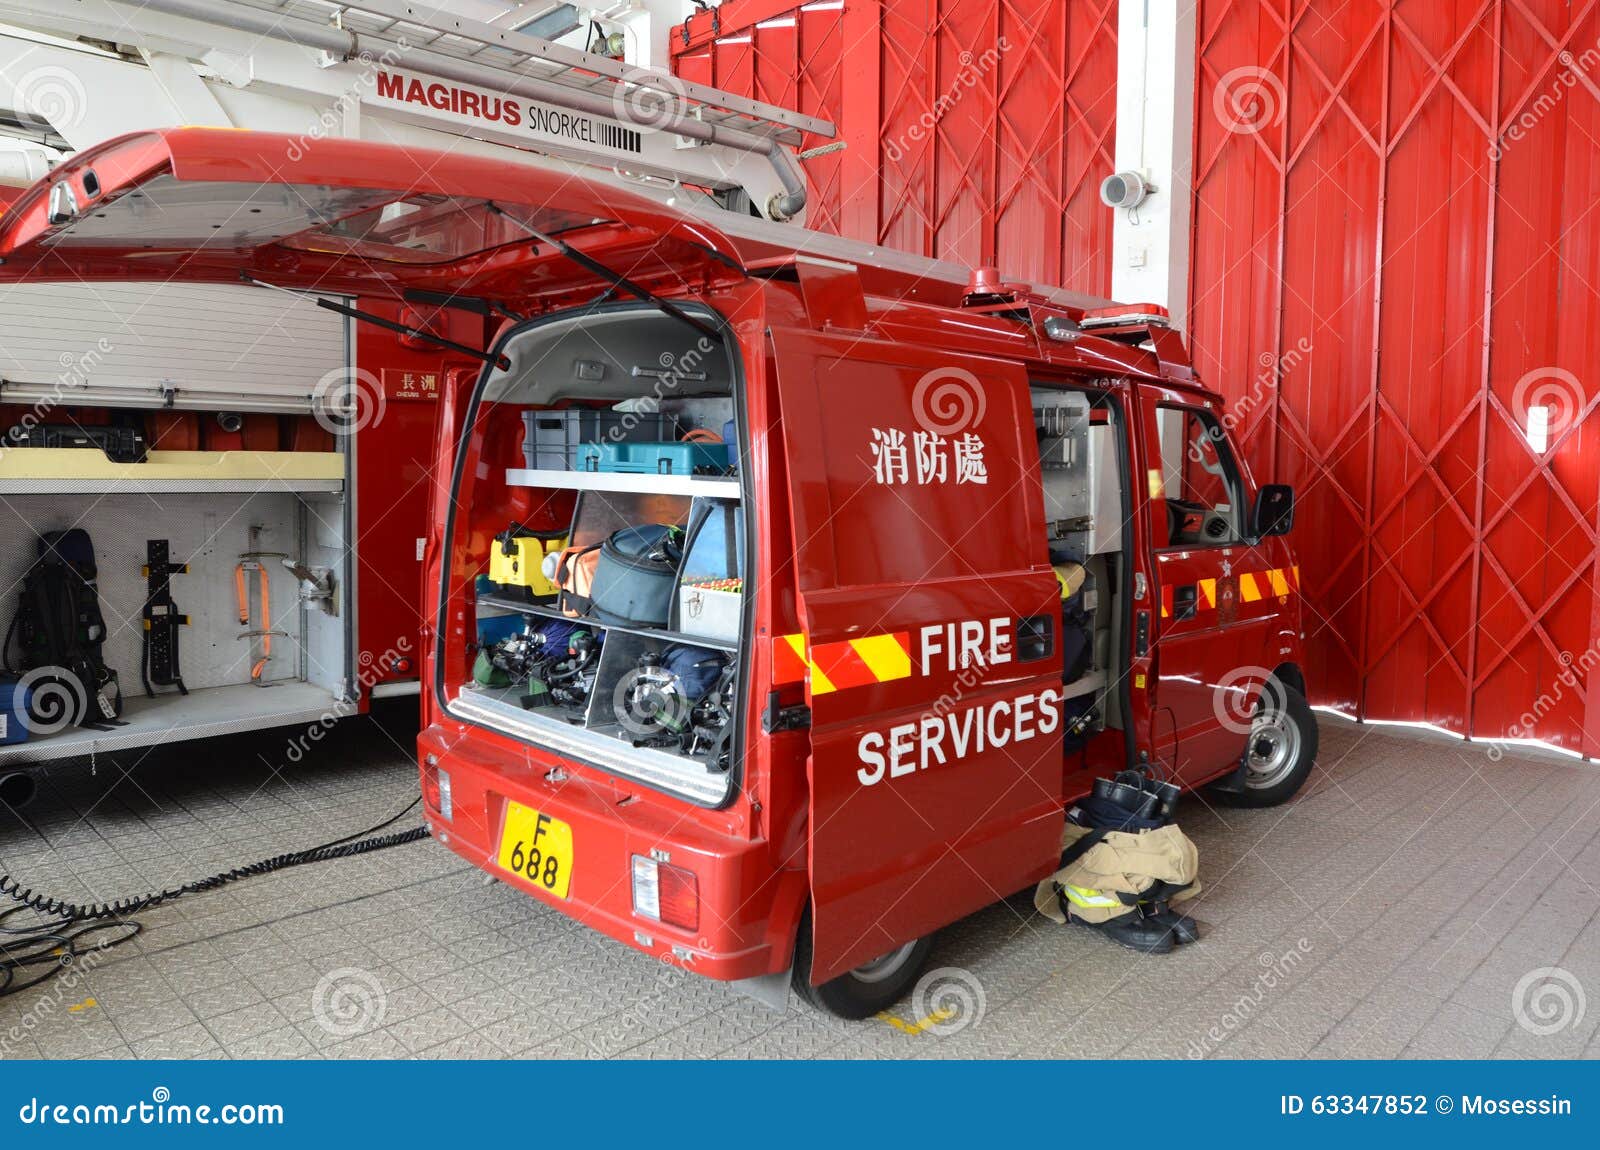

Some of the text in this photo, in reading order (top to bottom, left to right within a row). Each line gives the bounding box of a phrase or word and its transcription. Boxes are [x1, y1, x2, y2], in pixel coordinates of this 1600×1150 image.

[377, 71, 596, 143] MAGIRUS SNORKEL
[869, 427, 988, 485] 消防處
[920, 616, 1012, 677] FIRE
[856, 688, 1060, 787] SERVICES
[533, 813, 552, 846] F
[511, 840, 558, 888] 688
